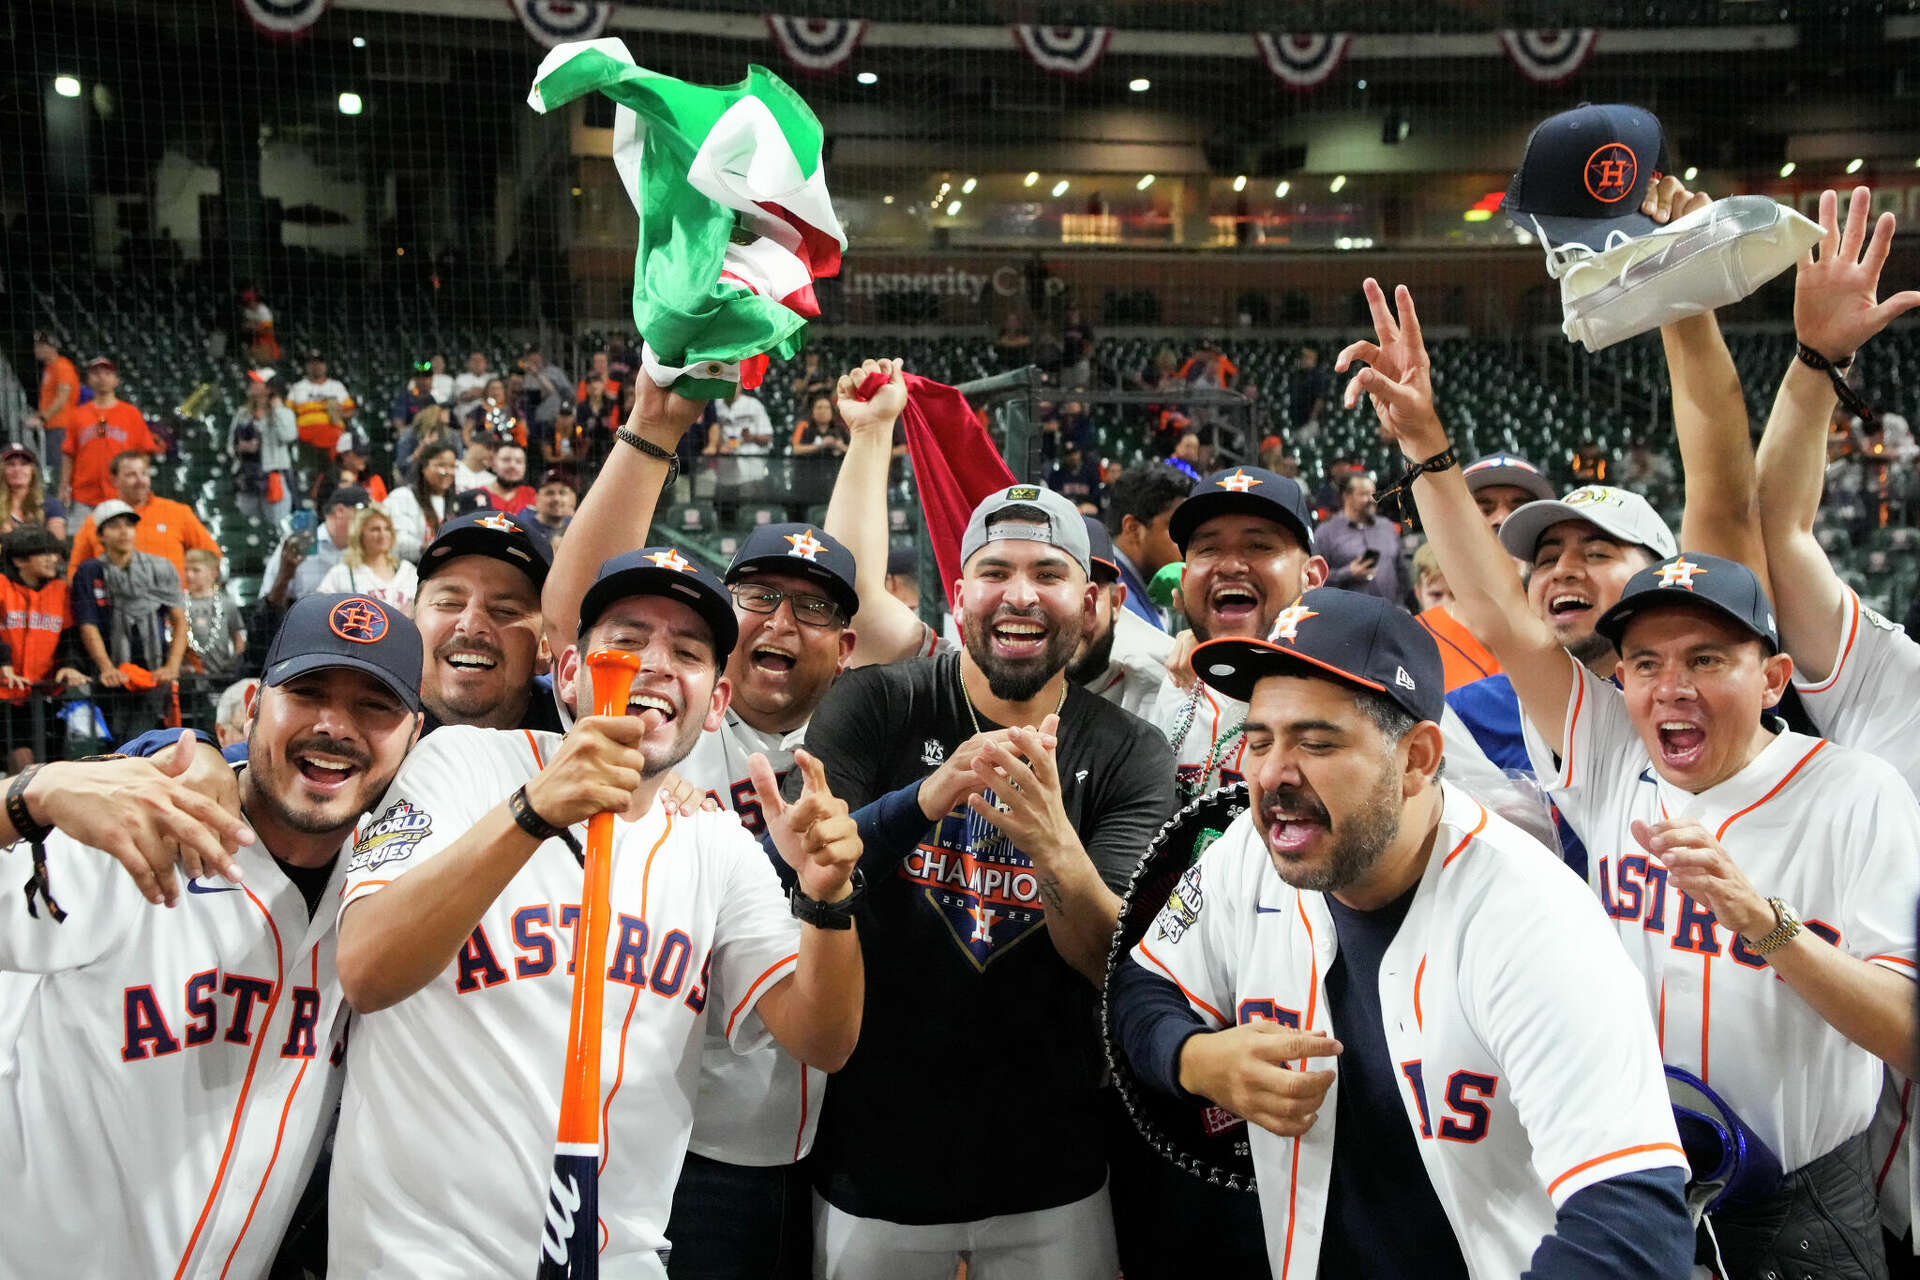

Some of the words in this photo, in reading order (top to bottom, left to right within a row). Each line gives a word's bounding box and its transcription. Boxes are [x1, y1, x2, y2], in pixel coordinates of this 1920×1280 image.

[1599, 160, 1626, 187] H
[843, 263, 989, 303] Insperity
[344, 607, 376, 632] H
[924, 741, 943, 760] WS
[361, 813, 432, 841] WORLD
[346, 842, 415, 870] SERIES
[943, 840, 978, 859] WORD
[989, 855, 1036, 868] SERIE
[903, 848, 1043, 905] CHAMPIO
[970, 904, 996, 943] H
[121, 968, 345, 1068] ASTR
